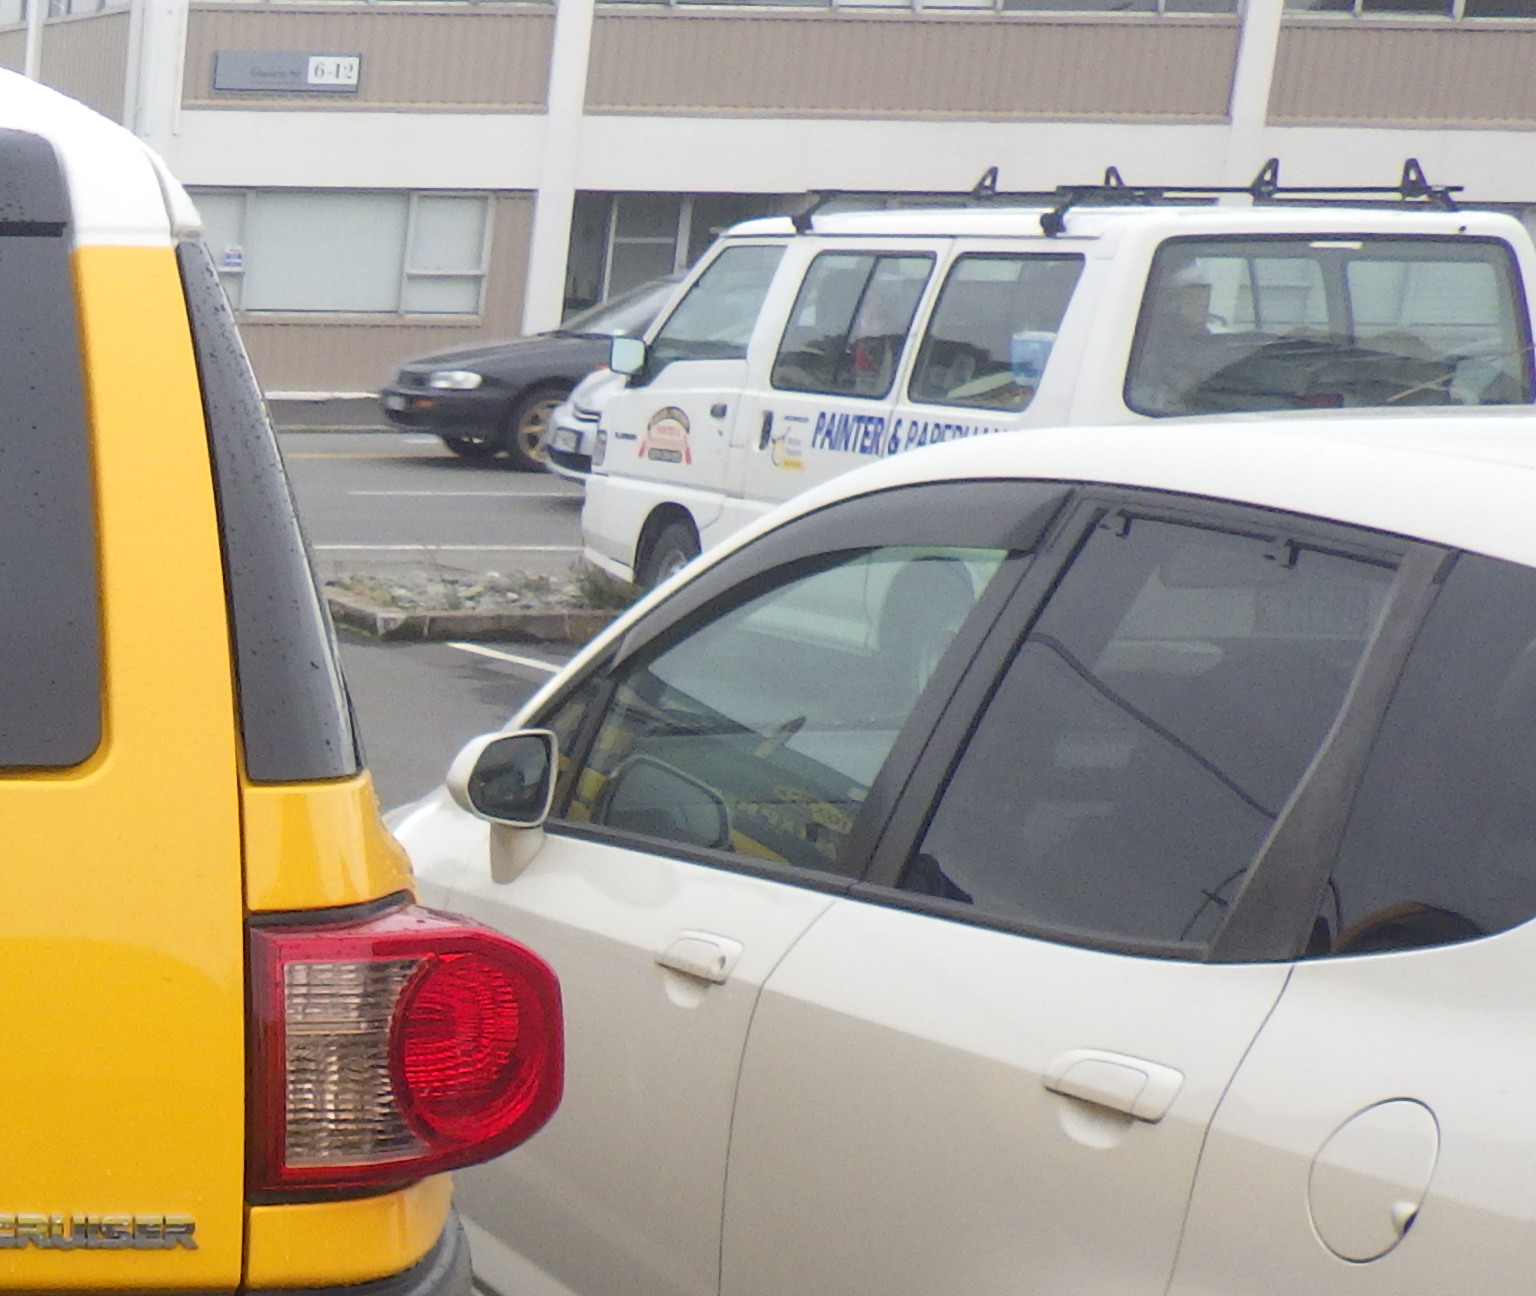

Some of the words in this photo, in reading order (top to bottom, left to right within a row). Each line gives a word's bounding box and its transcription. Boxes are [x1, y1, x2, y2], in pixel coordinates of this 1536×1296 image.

[313, 61, 354, 79] 6-12
[811, 410, 885, 457] PAINTER
[886, 417, 903, 456] &
